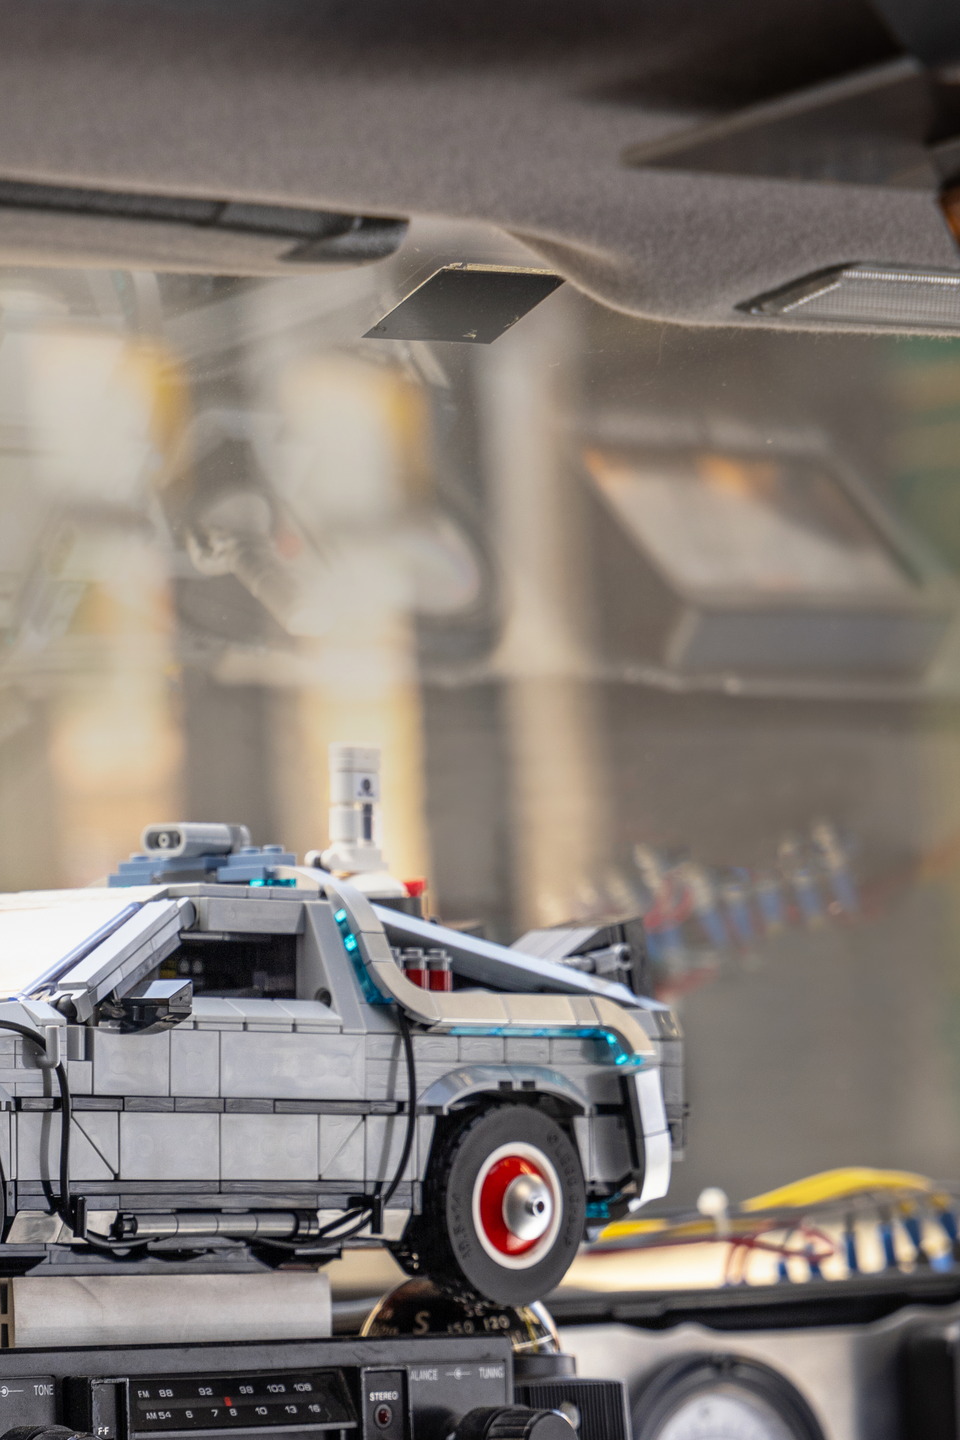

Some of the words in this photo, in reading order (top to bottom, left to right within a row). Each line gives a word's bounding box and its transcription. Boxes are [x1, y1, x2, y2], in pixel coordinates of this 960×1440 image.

[410, 1369, 439, 1380] ALANCE
[33, 1384, 54, 1396] TONE
[137, 1390, 150, 1398] FM
[159, 1389, 173, 1397] 88
[198, 1387, 213, 1396] 92
[239, 1386, 254, 1394] 98
[267, 1384, 286, 1393] 103
[293, 1383, 312, 1392] 108
[369, 1391, 398, 1401] STEREO
[146, 1412, 157, 1420] AM
[158, 1411, 171, 1419] 54
[211, 1409, 218, 1417] 7
[229, 1408, 238, 1417] 8
[255, 1406, 268, 1415] 10
[284, 1405, 297, 1414] 13
[308, 1404, 321, 1413] 16
